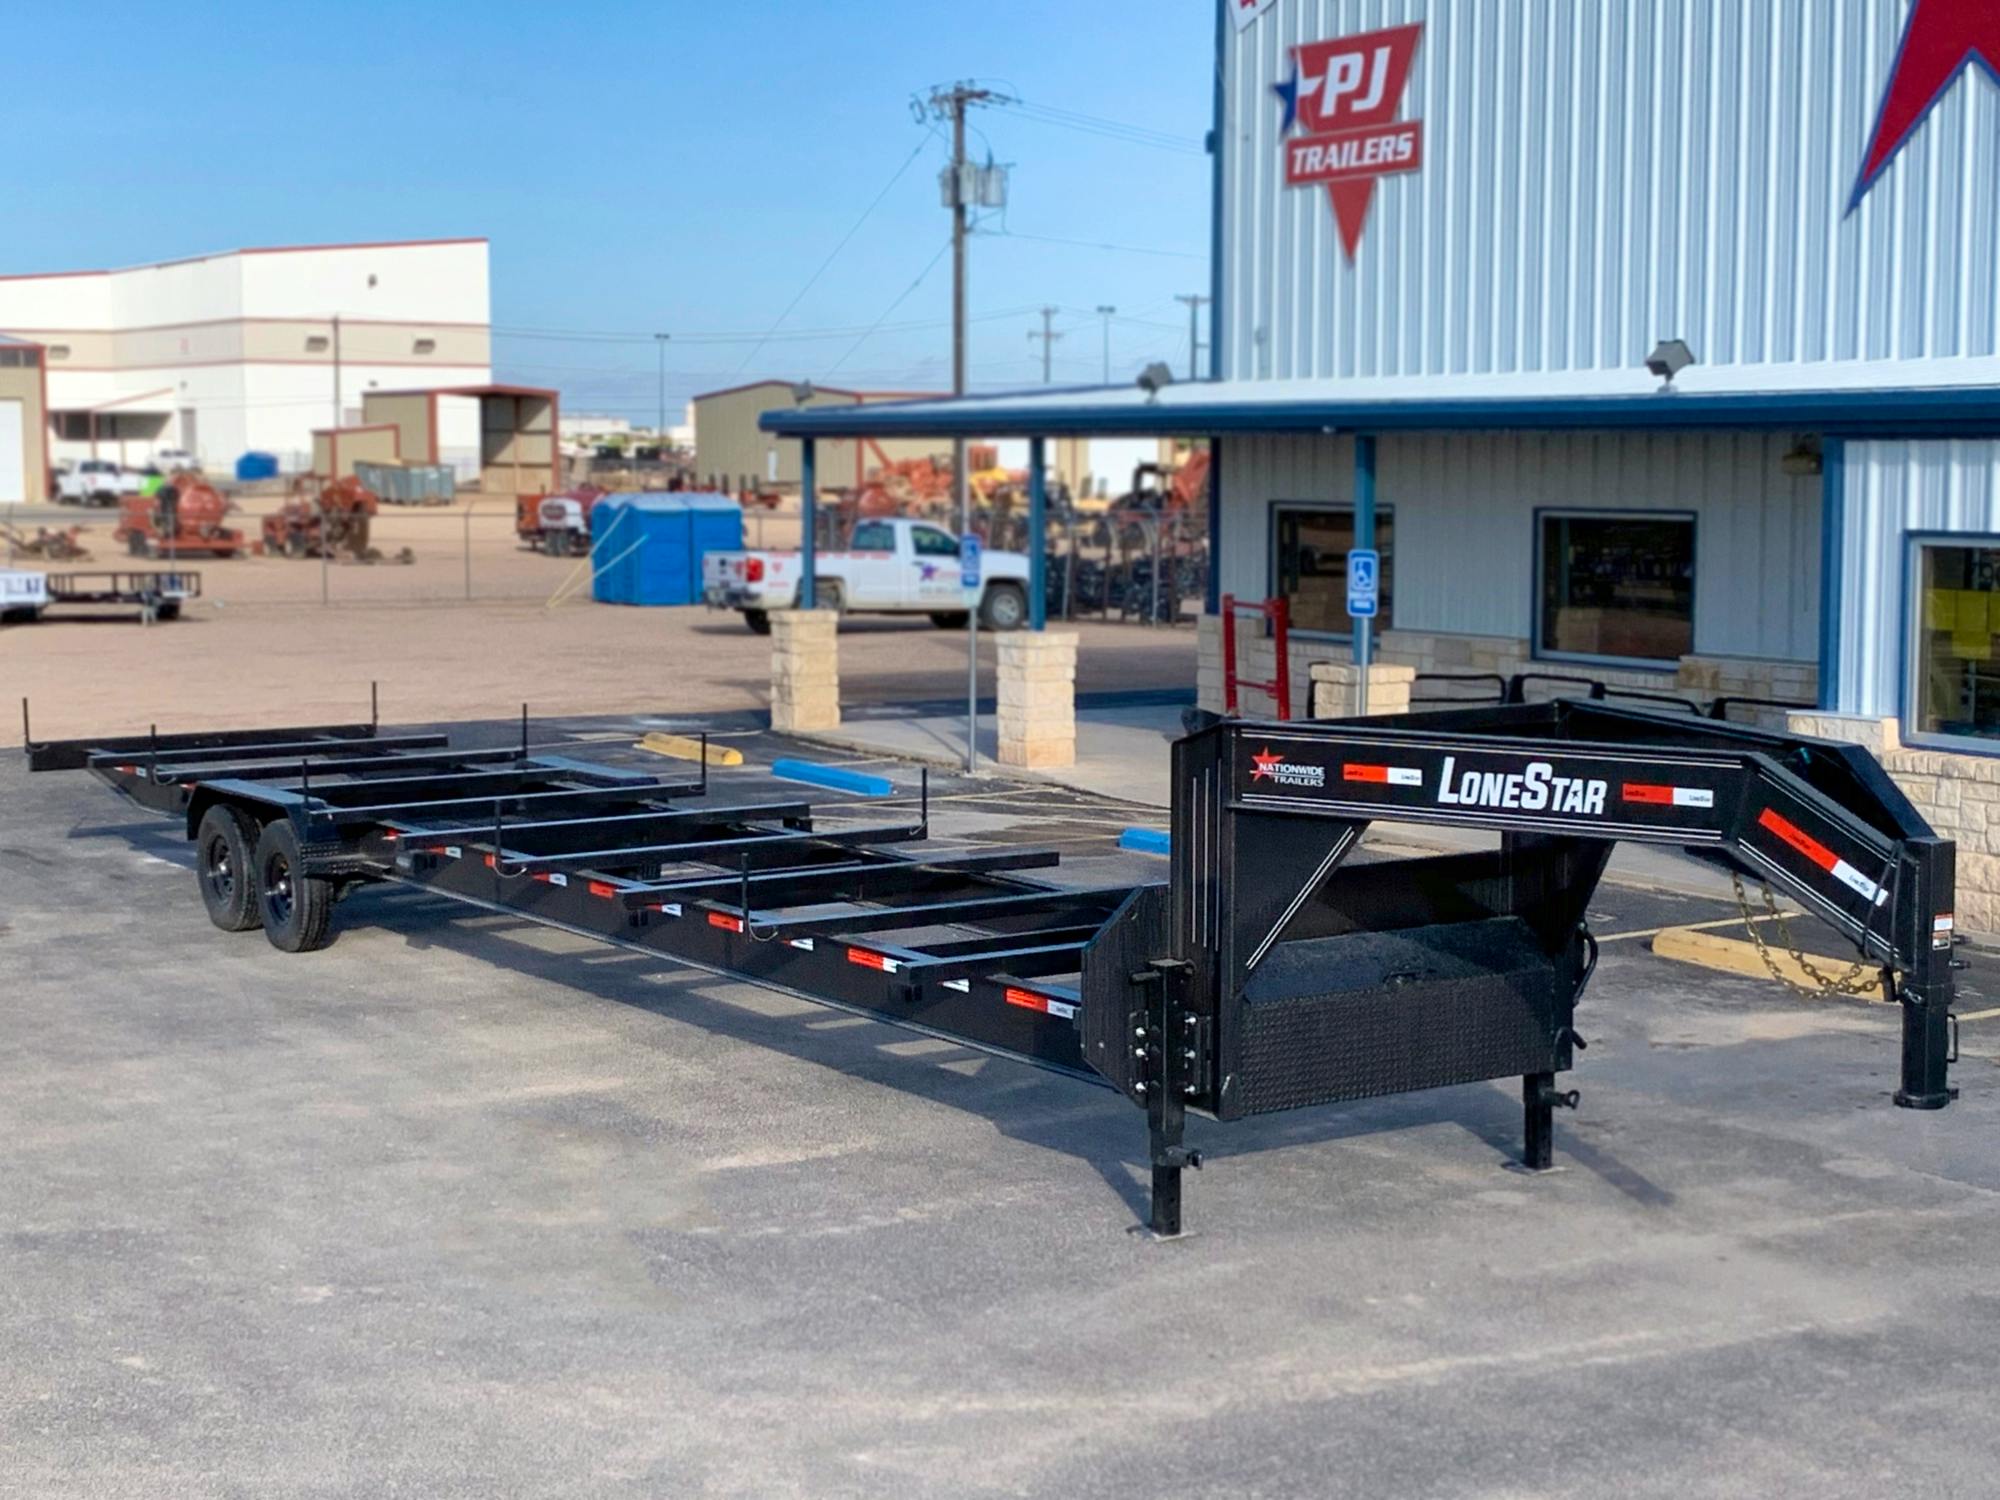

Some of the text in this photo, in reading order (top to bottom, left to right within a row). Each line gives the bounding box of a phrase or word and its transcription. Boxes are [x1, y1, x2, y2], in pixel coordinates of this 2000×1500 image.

[1319, 45, 1392, 118] PJ
[1292, 132, 1415, 176] TRAILERS
[1258, 762, 1325, 777] NATIONWIDE
[1273, 775, 1325, 788] TRAILERS
